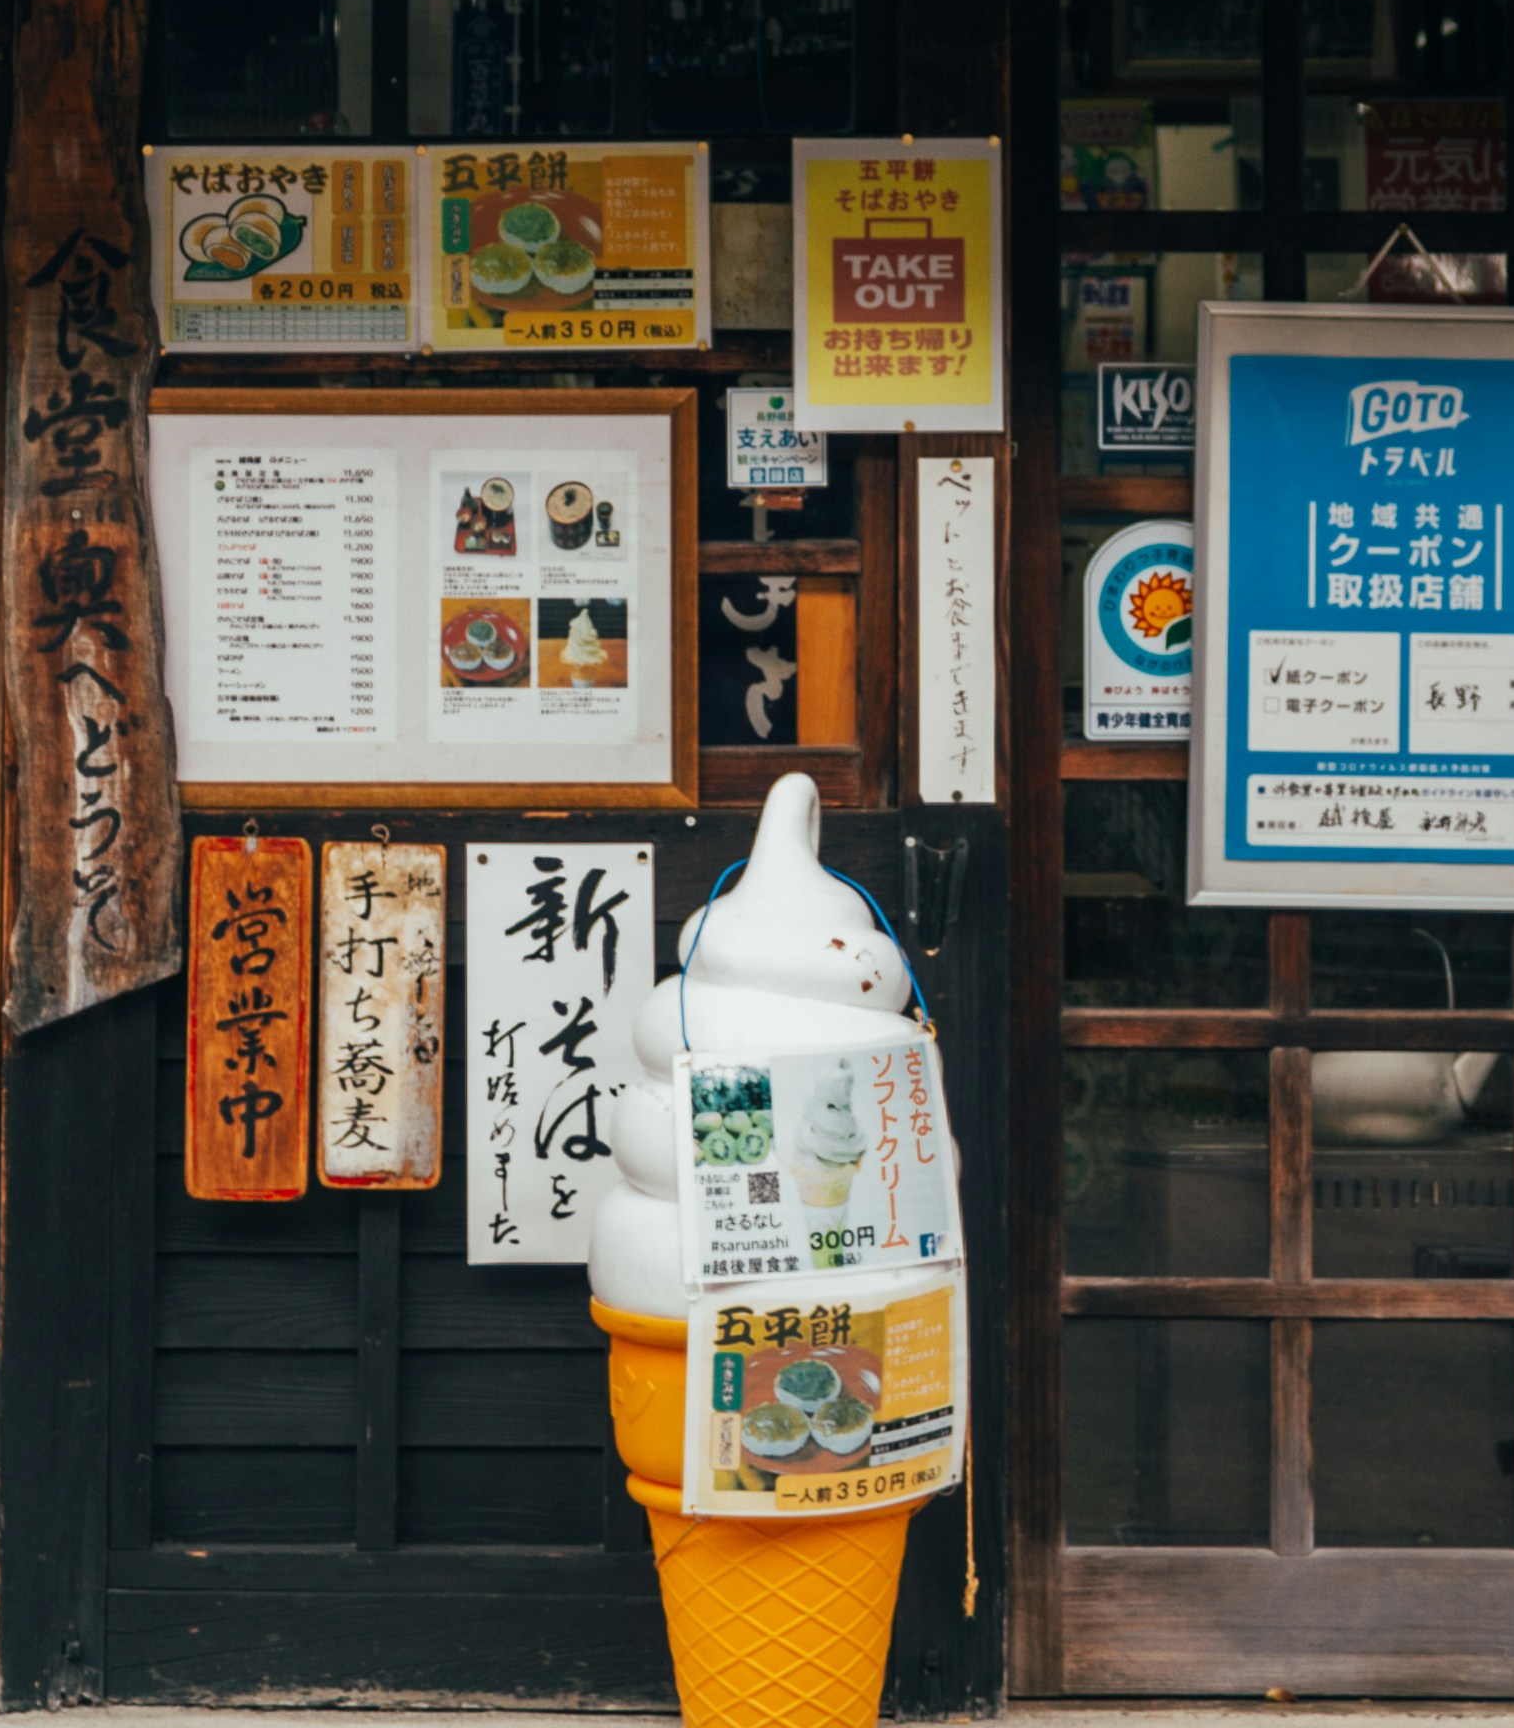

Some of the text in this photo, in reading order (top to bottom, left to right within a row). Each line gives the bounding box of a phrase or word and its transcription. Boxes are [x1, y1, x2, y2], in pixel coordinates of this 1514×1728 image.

[170, 163, 328, 195] そばおやき
[442, 151, 569, 193] 五平餅
[858, 158, 937, 181] 五平餅
[834, 187, 960, 212] そばおやき
[843, 254, 955, 279] TAKE
[371, 284, 403, 299] 税込
[854, 283, 944, 310] OUT
[823, 328, 973, 352] お持ち帰り
[1112, 368, 1192, 432] KISO
[737, 428, 818, 449] 支えあい
[1360, 447, 1456, 477] トラベル
[1328, 502, 1483, 531] 地域共通
[1329, 533, 1483, 568] クーポン
[1327, 573, 1484, 611] 取扱店舗
[1286, 669, 1368, 685] 紙クーポン
[1286, 698, 1384, 714] 電子クーポン
[1426, 680, 1481, 712] 長野
[212, 880, 287, 1159] 営業中
[331, 871, 398, 1151] 手打ち蕎麦
[505, 856, 630, 1219] 新そばを
[905, 1047, 935, 1163] さるなし
[872, 1053, 910, 1249] ソフトクリーム
[716, 1213, 782, 1231] #さるなし
[712, 1235, 789, 1252] #sarunashi
[810, 1225, 875, 1250] 300円
[703, 1256, 800, 1276] #越後屋食堂
[714, 1303, 852, 1348] 五平餅
[782, 1470, 905, 1505] 一人前350円
